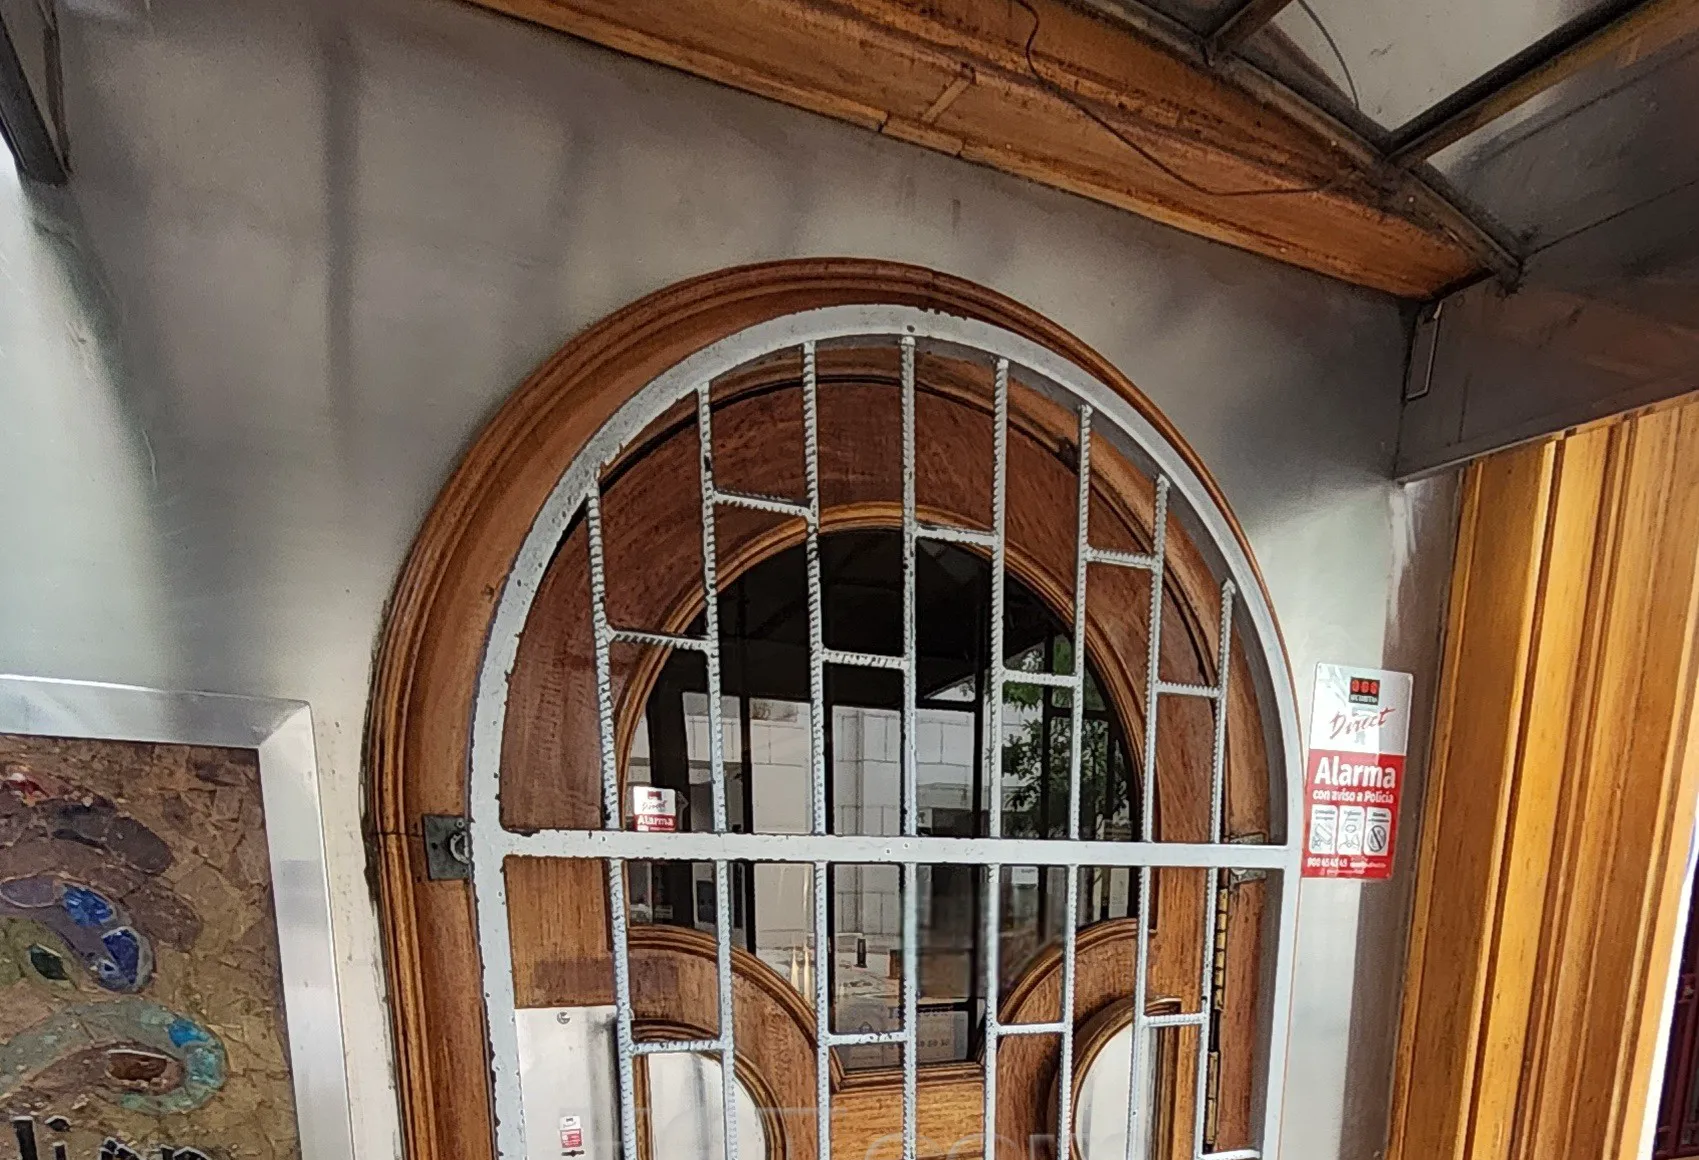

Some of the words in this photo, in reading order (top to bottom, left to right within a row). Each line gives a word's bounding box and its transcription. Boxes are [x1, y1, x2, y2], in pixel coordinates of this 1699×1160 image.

[1329, 708, 1395, 739] Direct
[1314, 756, 1396, 788] Alarma
[1313, 789, 1330, 801] con
[1331, 788, 1356, 802] aviso
[1357, 791, 1363, 802] a
[638, 814, 675, 826] Alarma
